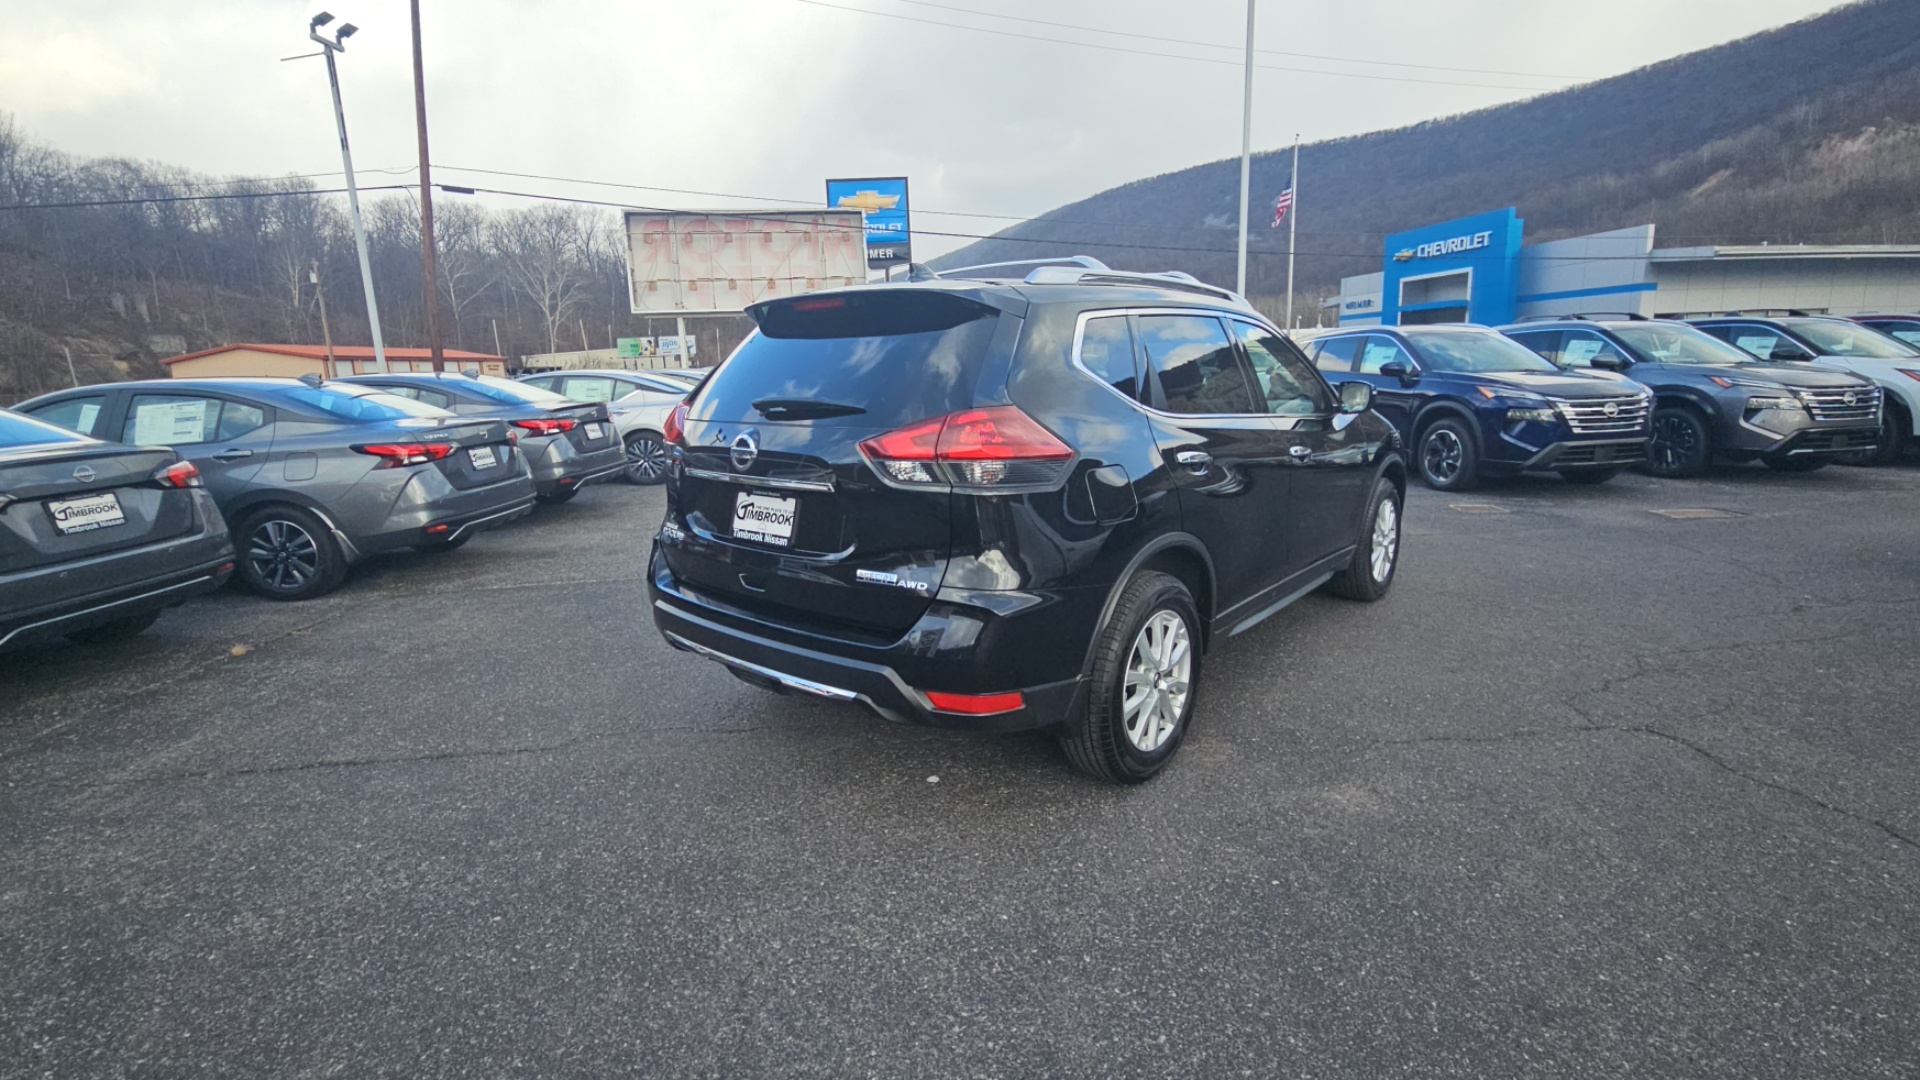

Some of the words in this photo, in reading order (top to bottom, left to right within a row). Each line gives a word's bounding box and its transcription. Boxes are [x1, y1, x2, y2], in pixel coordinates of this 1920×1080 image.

[867, 222, 903, 234] ROLET
[1417, 231, 1493, 257] CHEVROLET
[869, 249, 894, 259] MER
[54, 504, 118, 522] TIMBROOK
[736, 500, 795, 526] TIMBROOK
[64, 523, 99, 535] Timbrook
[733, 529, 763, 542] Timbrook
[763, 533, 788, 546] Nissan
[897, 580, 929, 591] AWD
